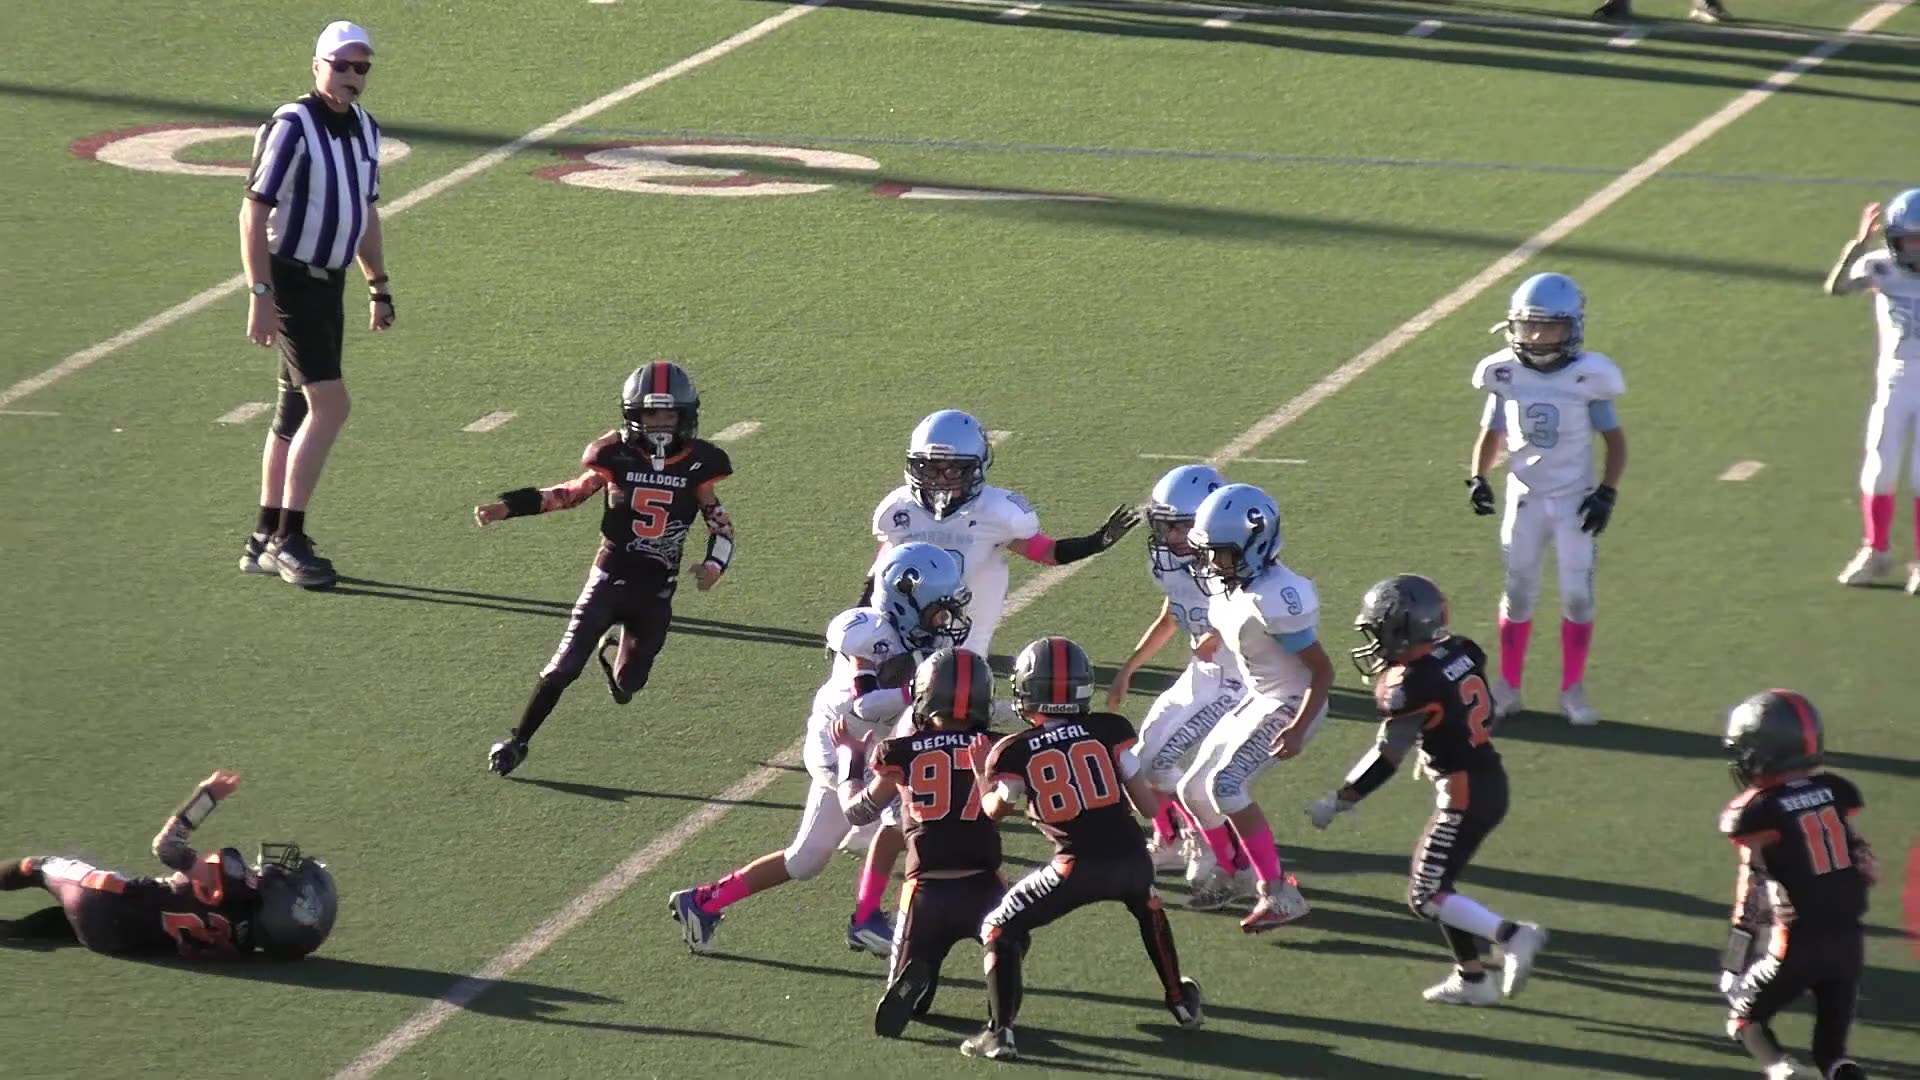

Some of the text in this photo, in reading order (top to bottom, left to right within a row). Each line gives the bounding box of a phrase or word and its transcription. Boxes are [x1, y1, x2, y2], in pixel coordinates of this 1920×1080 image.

[1526, 403, 1560, 449] 3
[626, 470, 688, 488] BULLDOGS
[631, 487, 673, 538] 5
[1280, 586, 1303, 616] 9
[1042, 704, 1077, 714] Riddell
[1459, 674, 1491, 748] 2
[908, 747, 985, 823] 97
[1025, 739, 1121, 824] 80
[1799, 806, 1851, 874] 11
